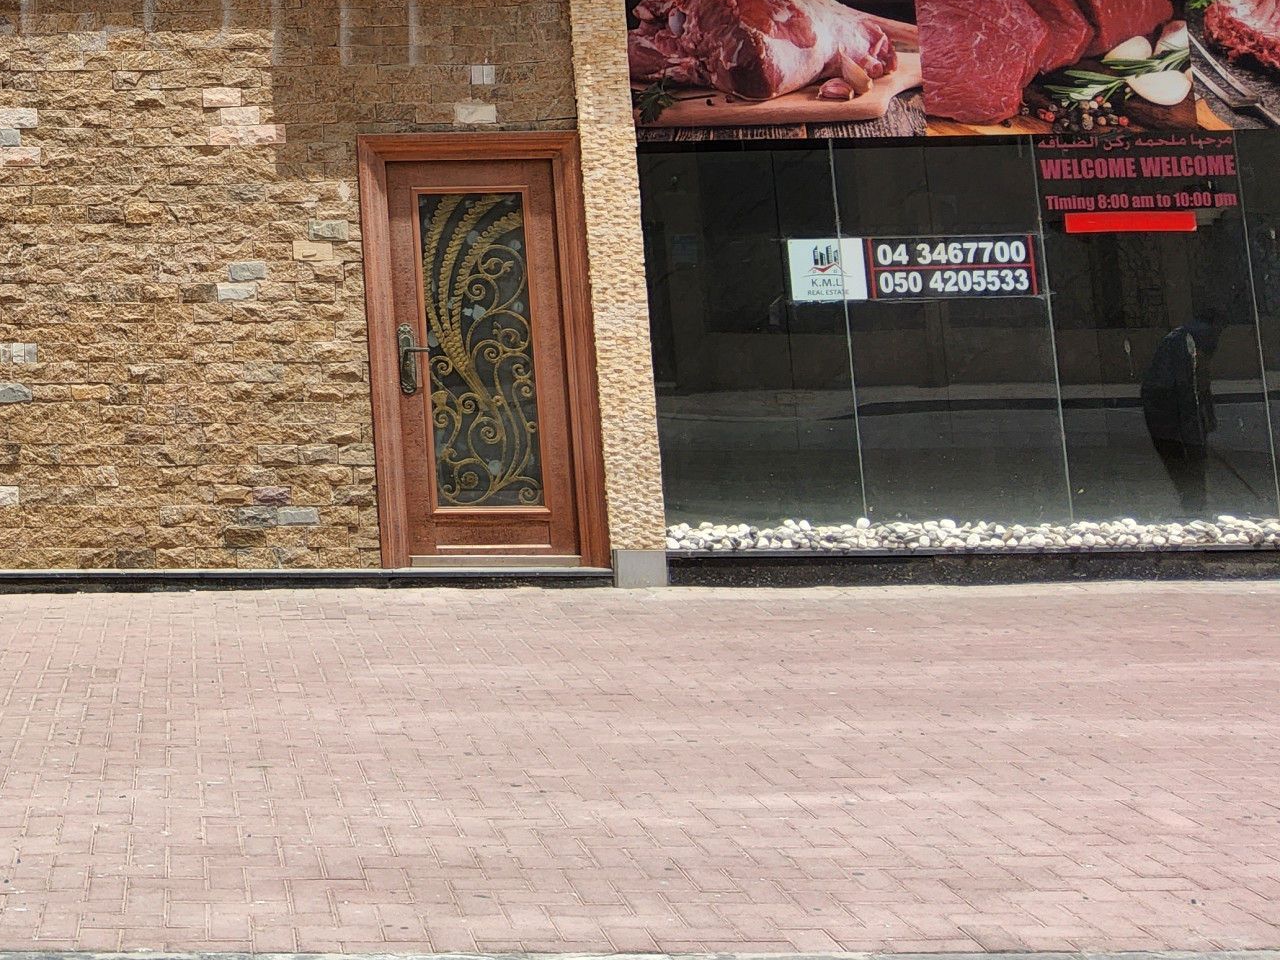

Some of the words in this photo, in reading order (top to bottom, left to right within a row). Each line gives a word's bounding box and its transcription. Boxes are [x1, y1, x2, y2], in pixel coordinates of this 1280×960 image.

[1040, 157, 1136, 180] WELCOME
[1140, 154, 1236, 178] WELCOME
[1045, 195, 1095, 211] Timing
[1097, 193, 1129, 209] 8:00
[1132, 195, 1154, 208] am
[1157, 193, 1170, 207] to
[1173, 191, 1212, 207] 10:00
[877, 243, 909, 265] 04
[917, 241, 1026, 265] 3467700
[879, 271, 923, 293] 050
[929, 269, 1030, 292] 4205533
